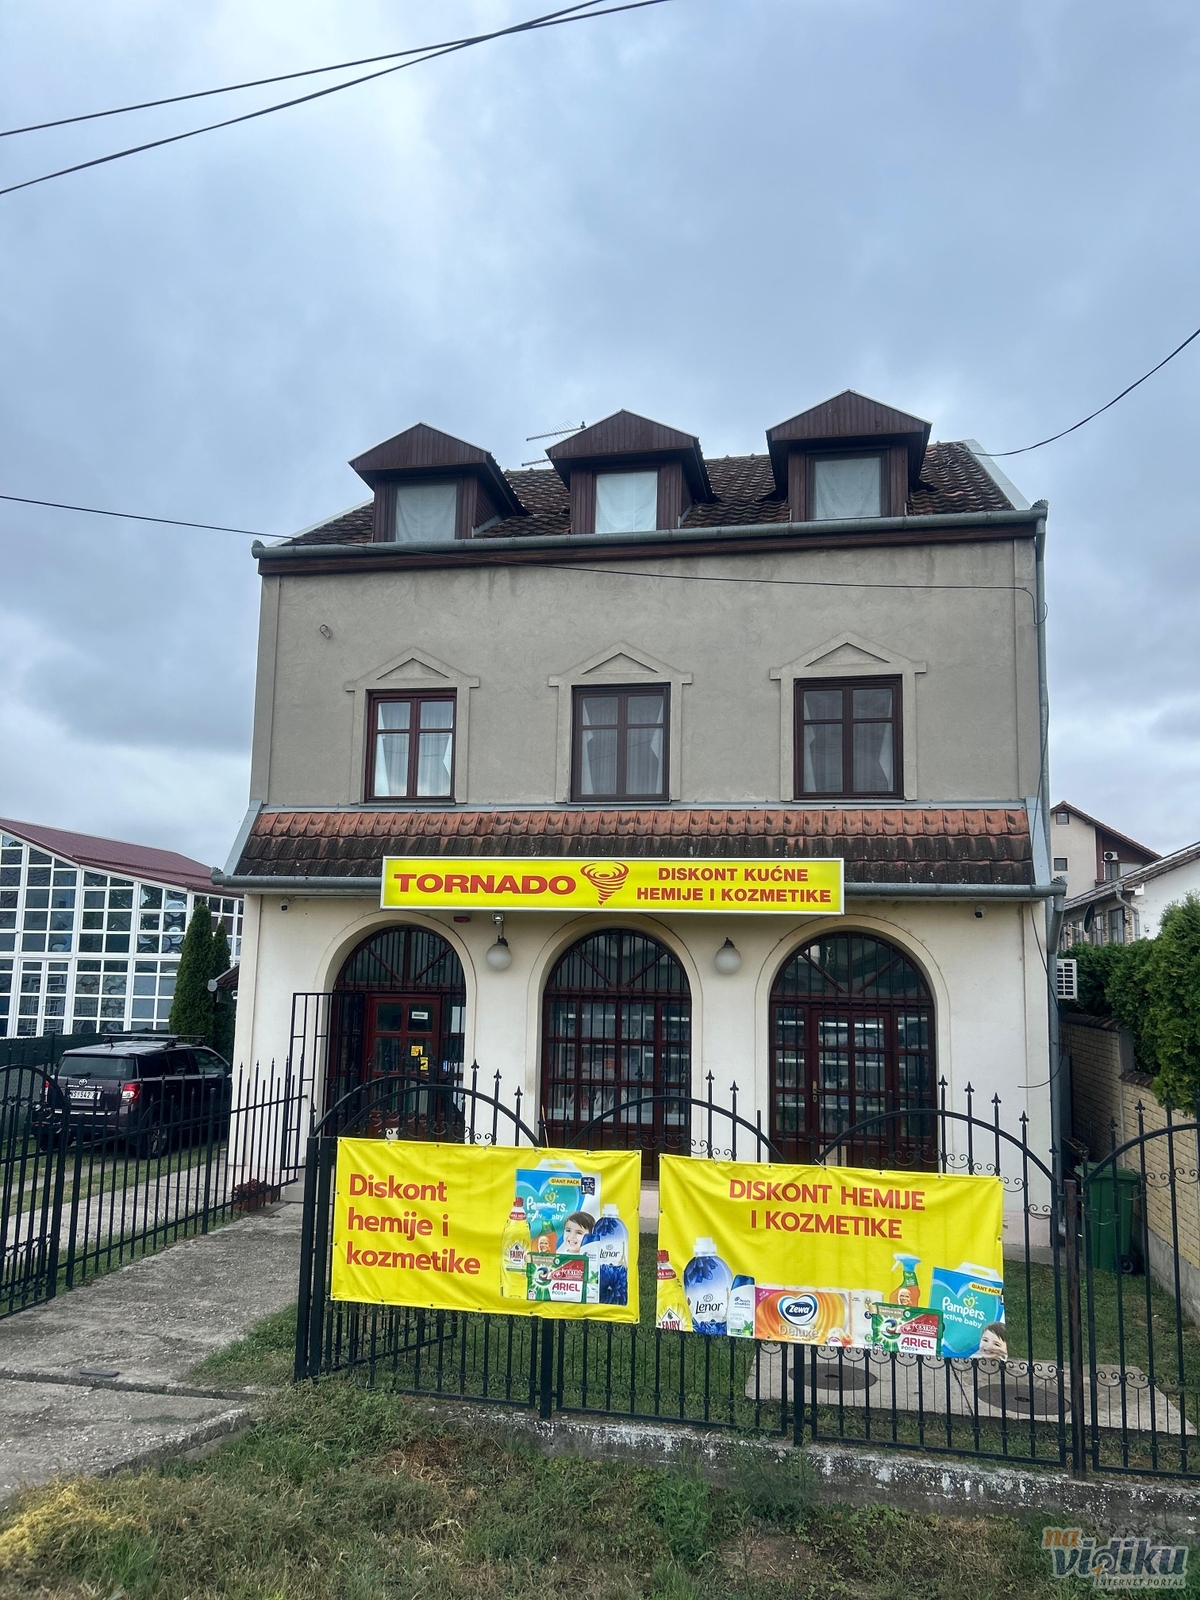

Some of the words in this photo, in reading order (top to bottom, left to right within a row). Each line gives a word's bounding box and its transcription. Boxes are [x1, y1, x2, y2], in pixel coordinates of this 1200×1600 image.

[659, 867, 737, 881] DISKONT
[744, 866, 808, 882] KUĆNE
[393, 873, 577, 896] TORNADO
[636, 887, 703, 901] HEMIJE
[709, 888, 715, 901] I
[720, 888, 831, 903] KOZMETIKE
[349, 1173, 447, 1203] Diskont
[729, 1178, 833, 1204] DISKONT
[840, 1186, 926, 1211] HEMIJE
[347, 1206, 433, 1241] hemije
[441, 1214, 449, 1237] i
[750, 1209, 757, 1229] I
[765, 1210, 903, 1240] KOZMETIKE
[346, 1241, 481, 1275] kozmetike
[510, 1251, 525, 1260] FAIRY
[600, 1248, 620, 1259] Lenor
[552, 1282, 580, 1292] ARIEL
[971, 1283, 988, 1292] GIANT
[988, 1287, 1000, 1295] PACK
[695, 1301, 723, 1314] Lenor
[789, 1304, 810, 1314] Zewa
[661, 1320, 681, 1331] FAIRY
[964, 1317, 982, 1328] baby
[779, 1324, 819, 1338] Deluxe
[901, 1336, 934, 1350] ARIEL
